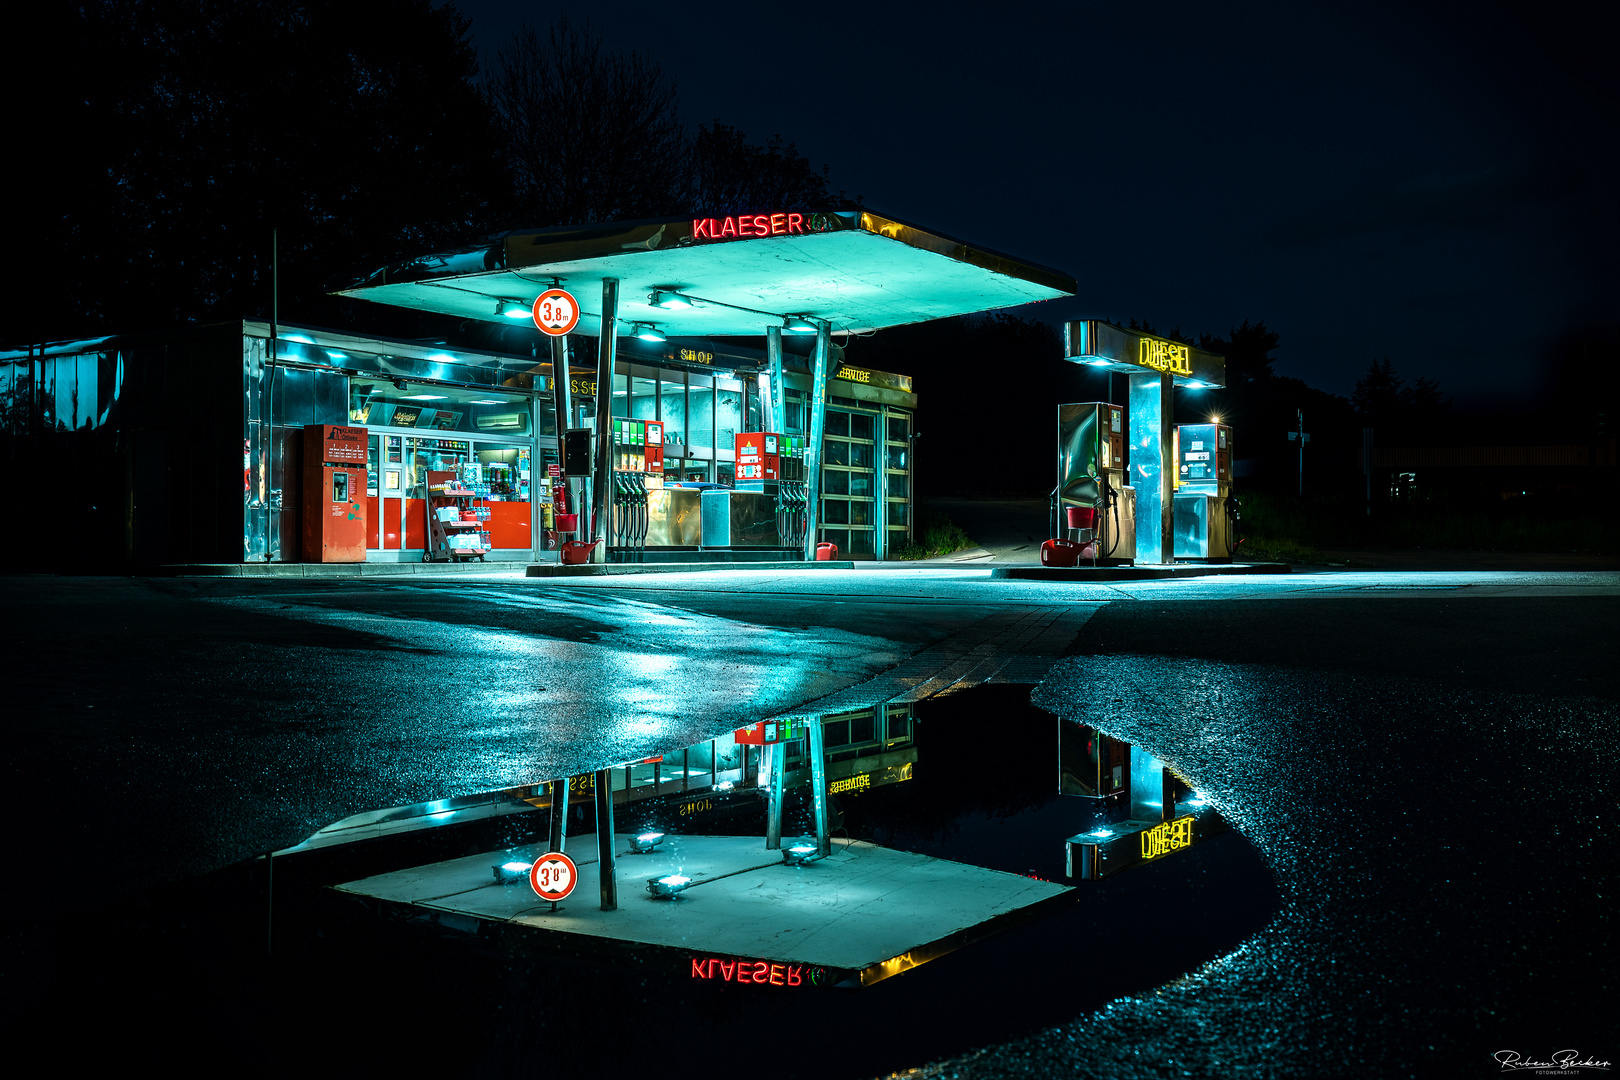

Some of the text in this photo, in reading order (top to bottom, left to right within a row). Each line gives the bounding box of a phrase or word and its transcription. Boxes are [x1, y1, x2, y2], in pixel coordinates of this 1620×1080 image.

[693, 212, 804, 239] KLAESER
[680, 348, 713, 365] SHOP
[1139, 337, 1193, 375] DIESEL
[836, 367, 870, 383] ERVICE
